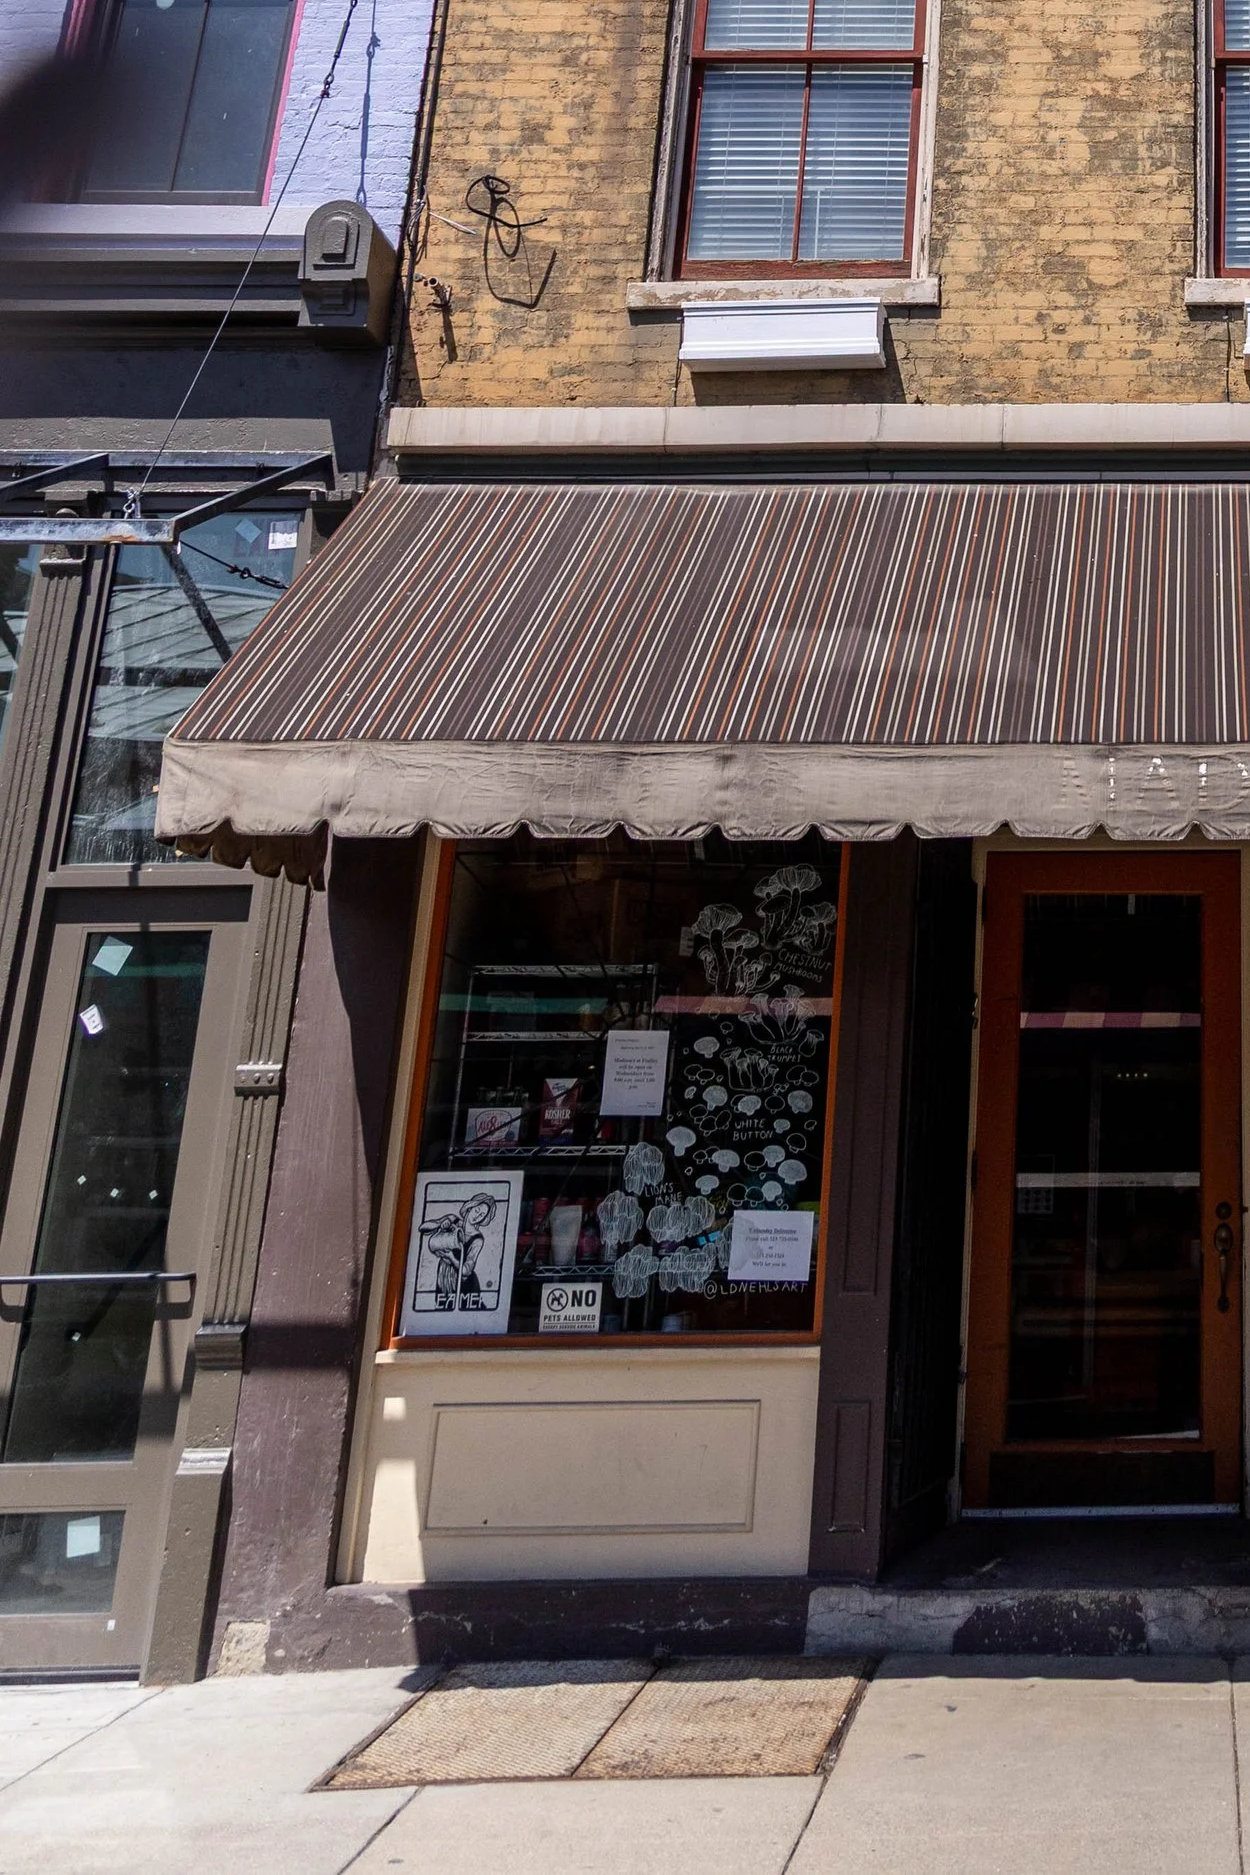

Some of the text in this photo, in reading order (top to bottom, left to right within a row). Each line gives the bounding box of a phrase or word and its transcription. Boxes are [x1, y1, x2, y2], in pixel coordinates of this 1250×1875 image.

[778, 947, 833, 971] CHESTNUT
[773, 962, 823, 983] MUSHROOMS
[544, 1109, 571, 1120] KOSHER
[734, 1118, 766, 1129] WHITE
[733, 1130, 774, 1141] BUTTON
[644, 1182, 674, 1198] LION'S
[655, 1190, 683, 1206] MANE
[571, 1289, 597, 1307] NO
[543, 1313, 596, 1322] PETS ALLOWED
